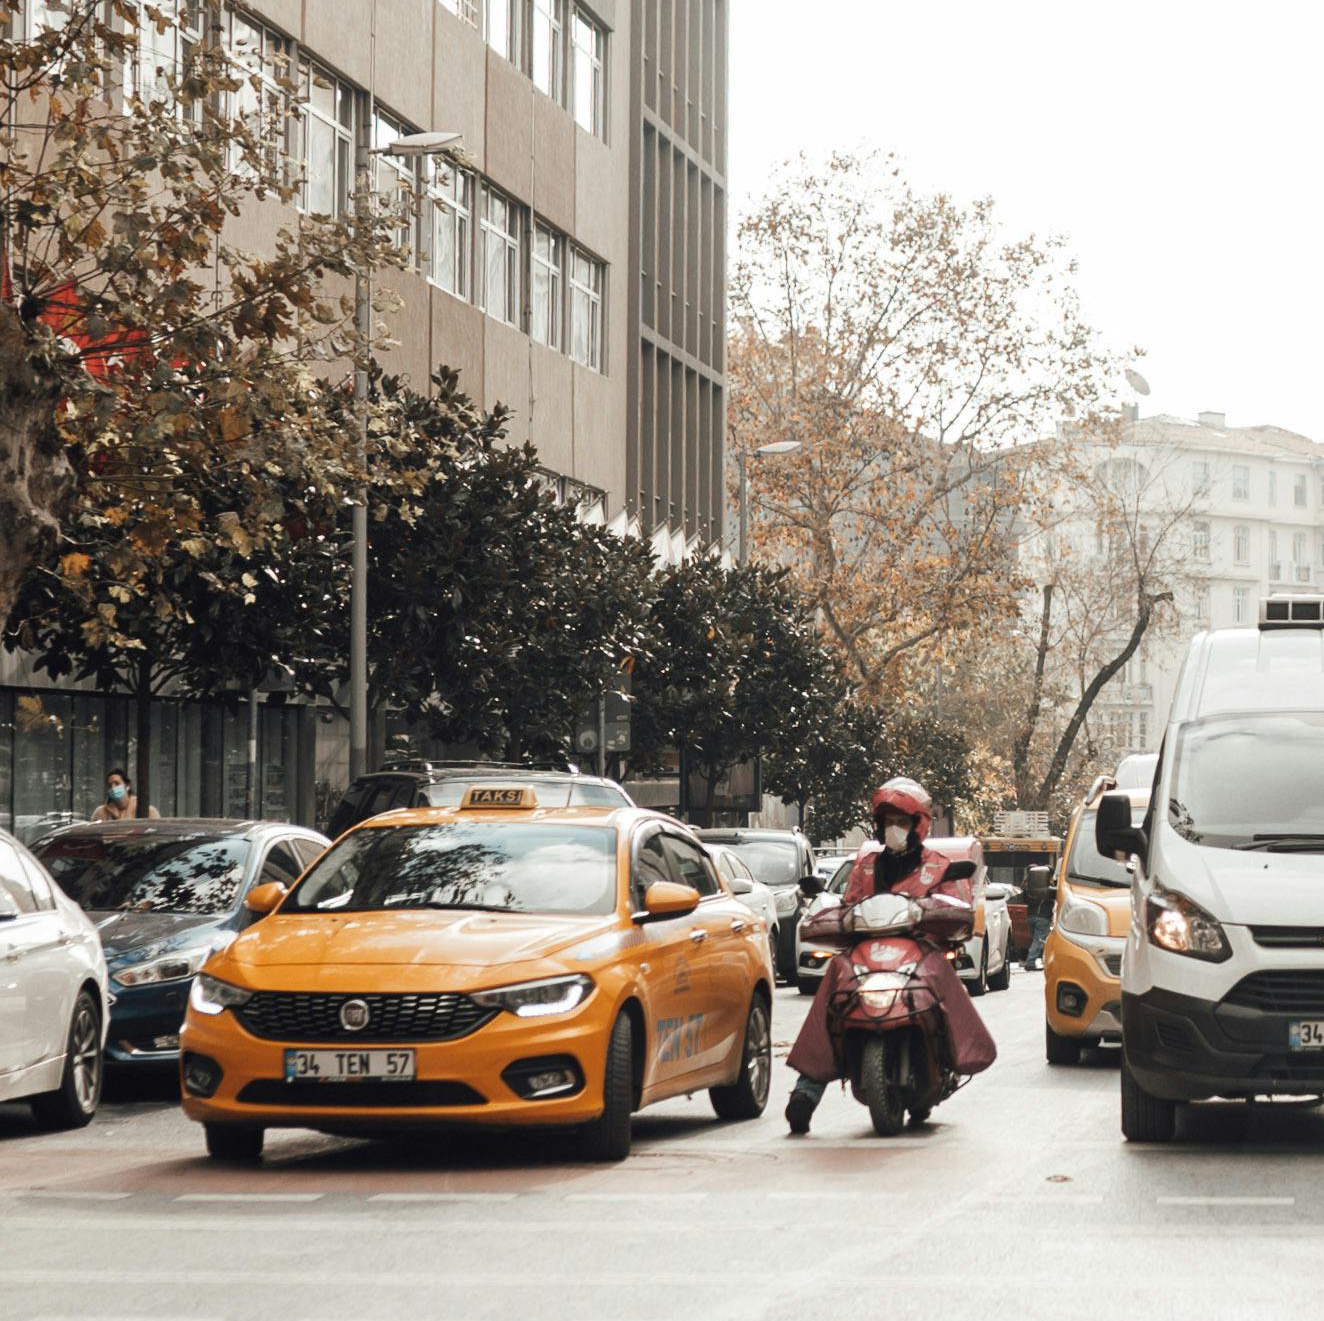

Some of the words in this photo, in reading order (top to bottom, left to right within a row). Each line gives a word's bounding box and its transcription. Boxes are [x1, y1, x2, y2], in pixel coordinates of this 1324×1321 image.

[1301, 1023, 1323, 1044] 34
[296, 1053, 320, 1075] 34
[335, 1052, 371, 1075] TEN
[386, 1052, 410, 1075] 57
